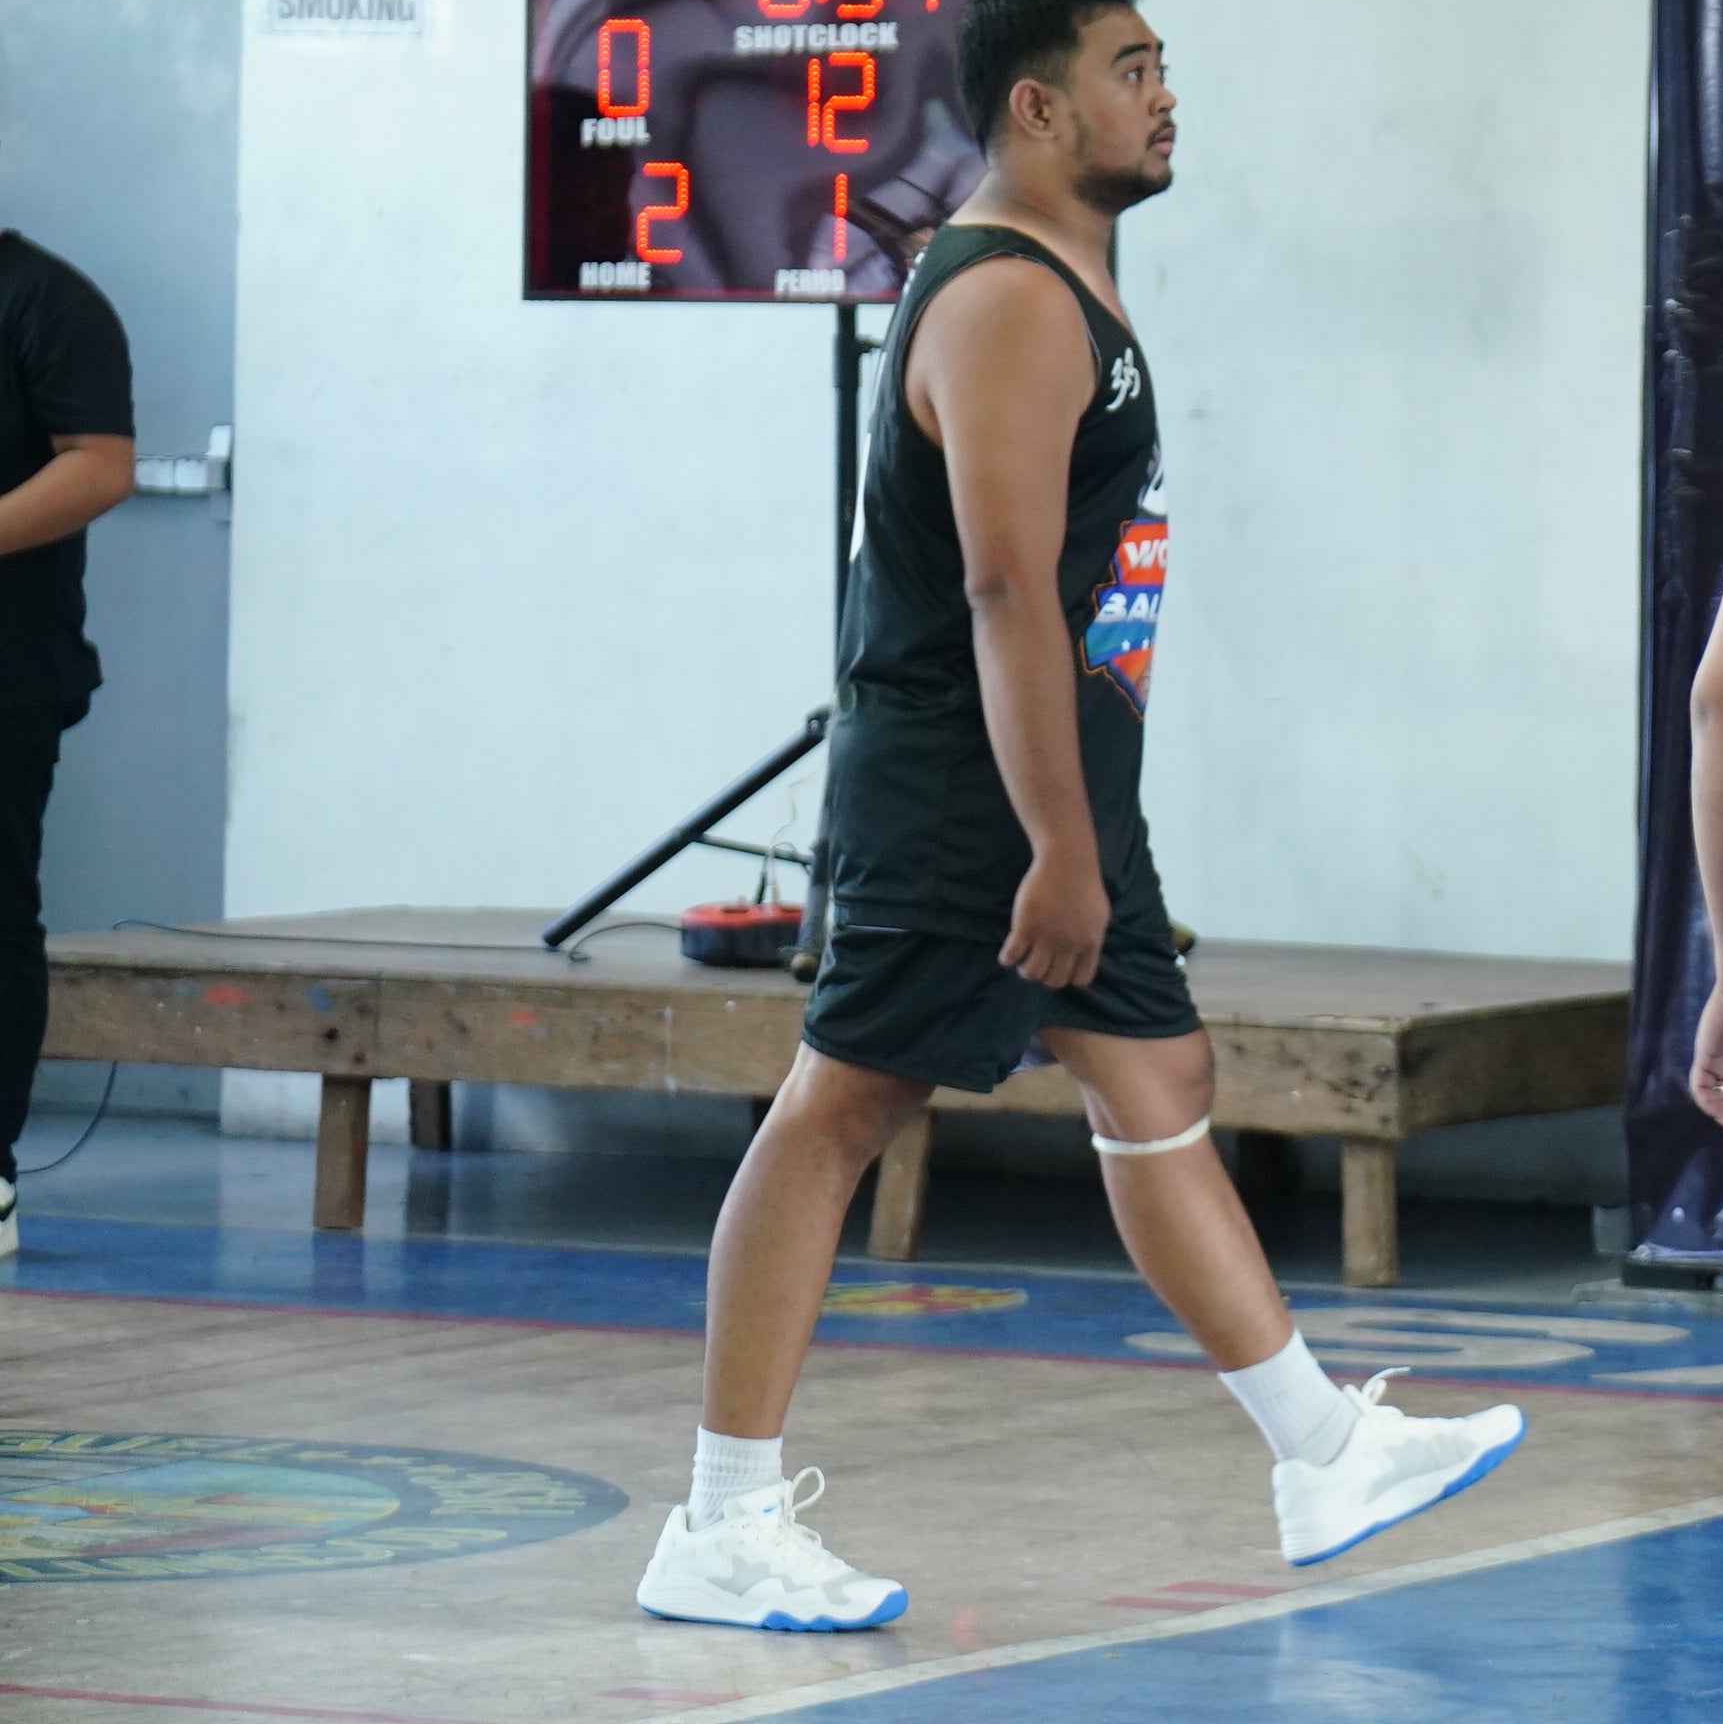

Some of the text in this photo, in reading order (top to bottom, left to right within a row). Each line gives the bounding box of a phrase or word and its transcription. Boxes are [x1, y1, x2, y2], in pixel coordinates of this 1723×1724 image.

[598, 18, 651, 118] 0
[734, 22, 899, 54] SHOTCLOCK
[580, 116, 650, 146] FOUL
[806, 51, 876, 154] 12
[636, 162, 690, 264] 2
[834, 173, 848, 263] 1
[579, 262, 650, 289] HOME
